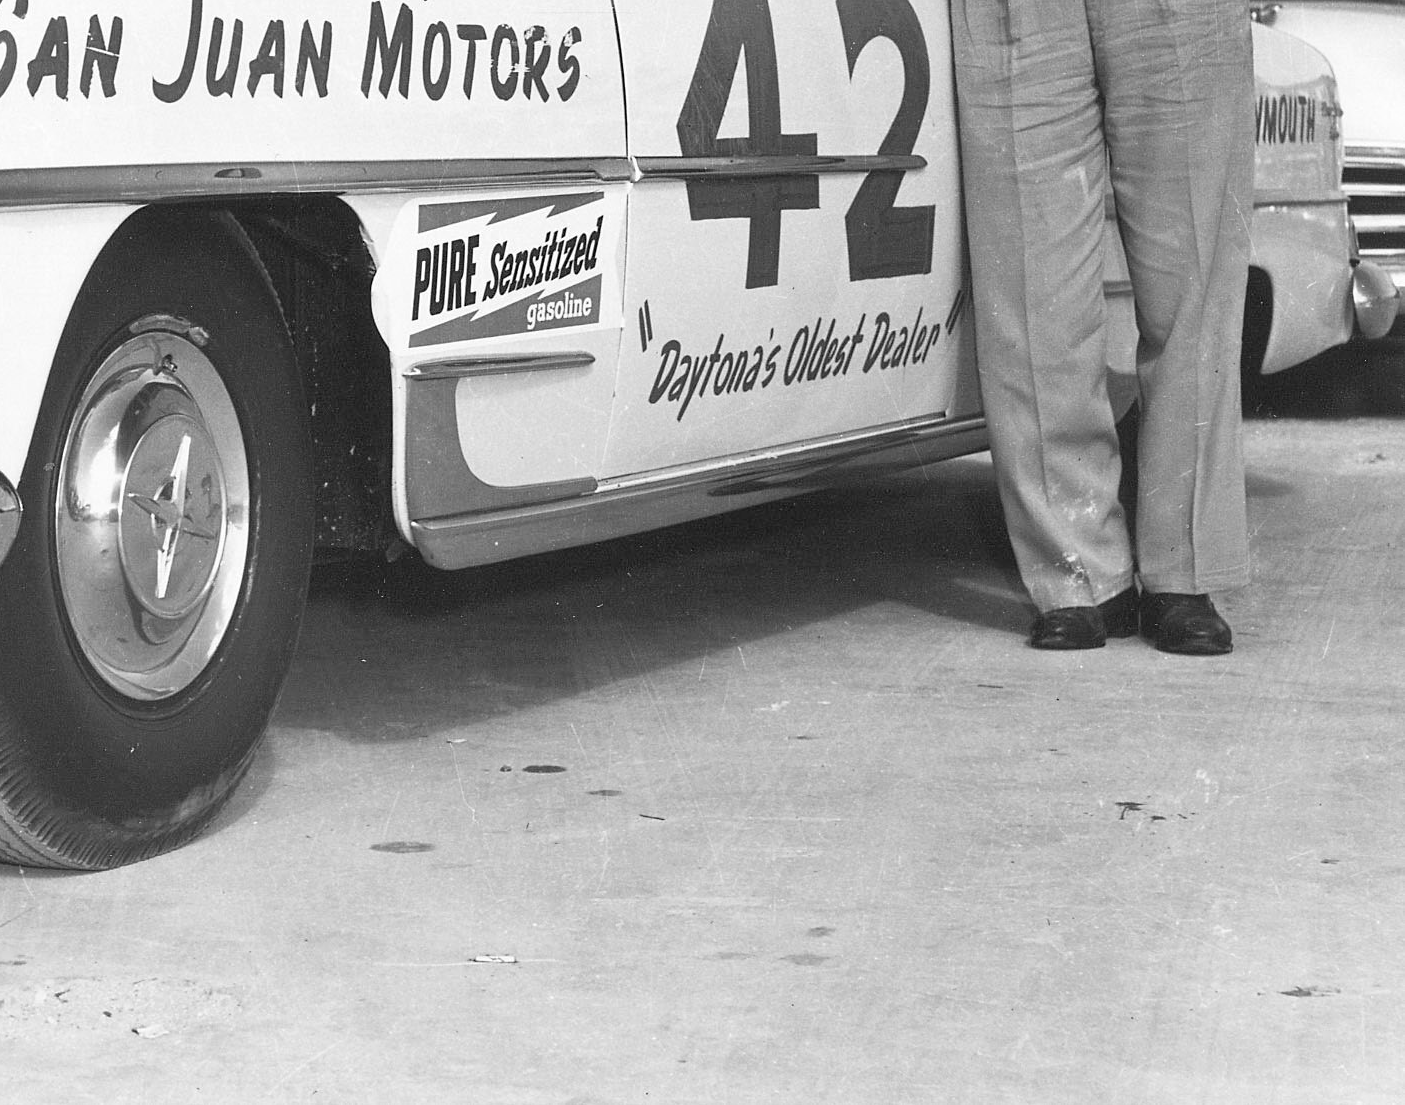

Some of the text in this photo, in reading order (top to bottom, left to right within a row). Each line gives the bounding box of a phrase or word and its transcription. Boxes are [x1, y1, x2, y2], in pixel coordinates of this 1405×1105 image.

[360, 0, 581, 103] MOTORS
[1254, 94, 1316, 146] YMOUTH
[411, 215, 604, 321] PURE Sensitized
[526, 292, 593, 330] gasoline
[783, 312, 867, 387] Oldest
